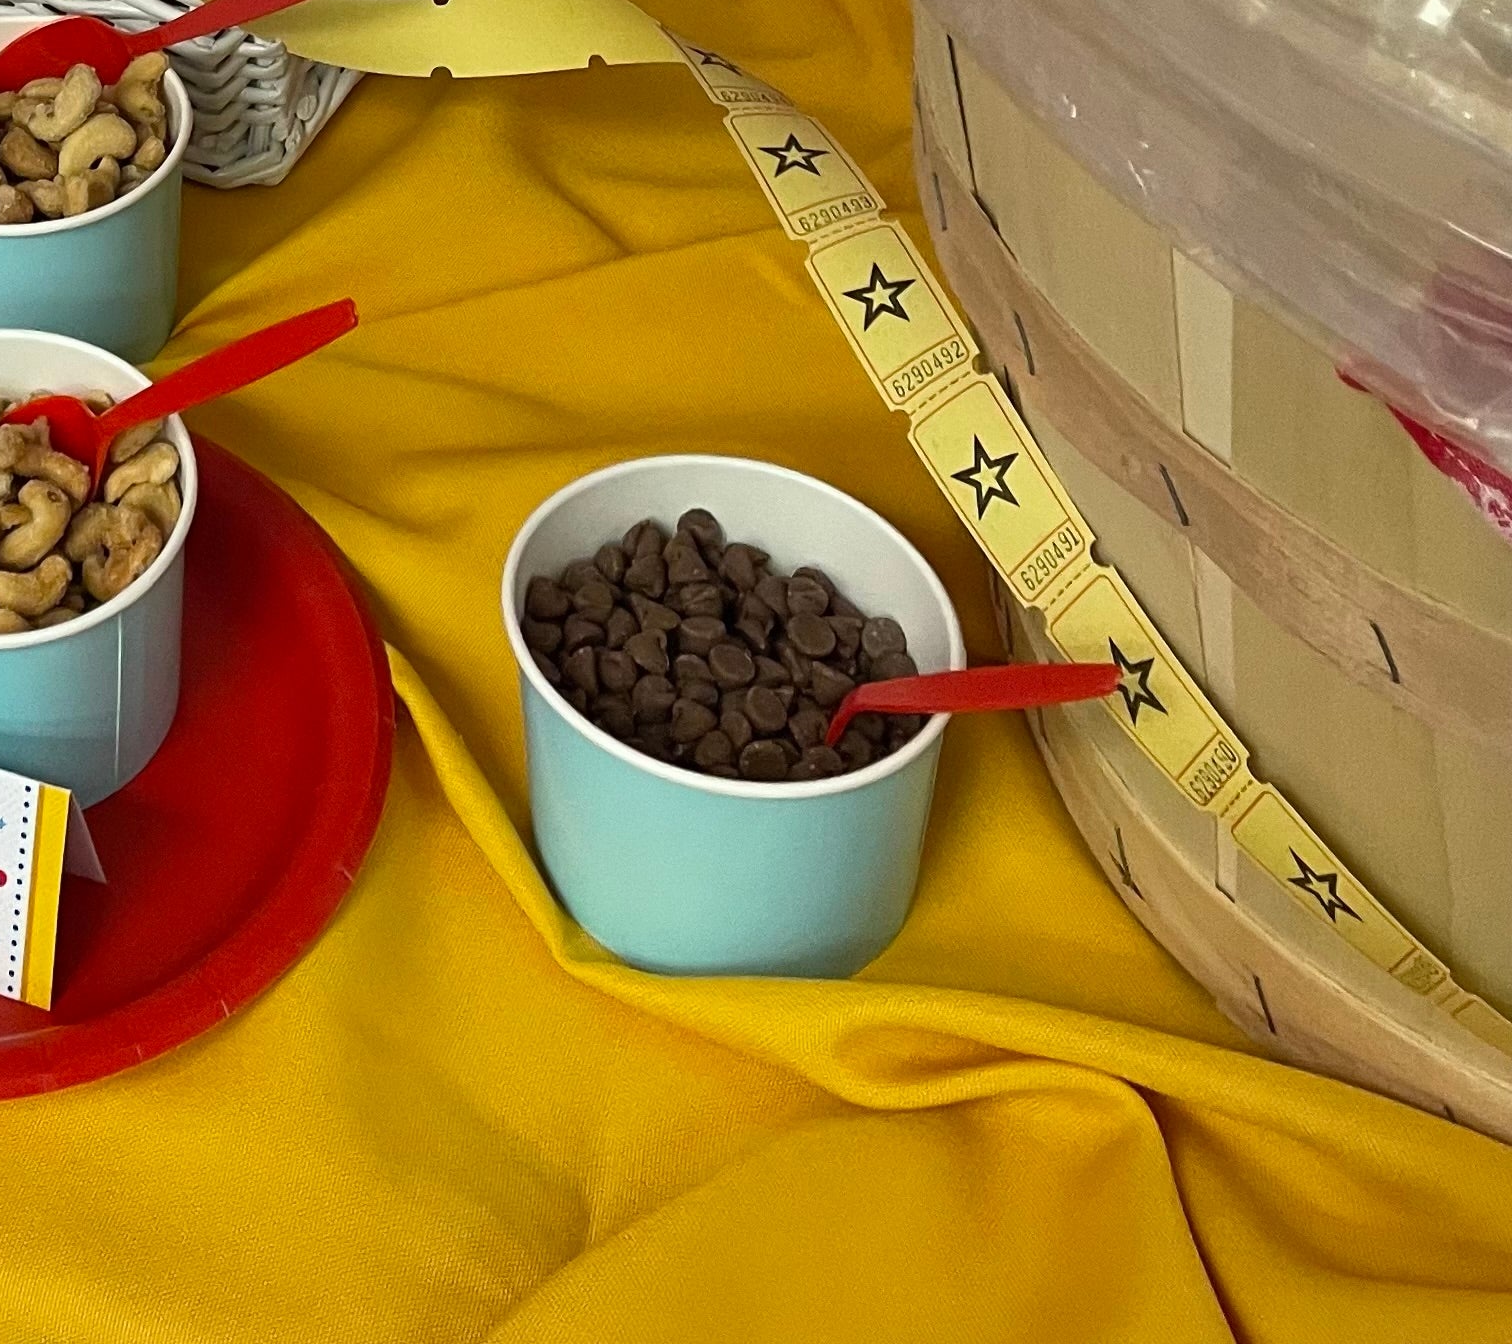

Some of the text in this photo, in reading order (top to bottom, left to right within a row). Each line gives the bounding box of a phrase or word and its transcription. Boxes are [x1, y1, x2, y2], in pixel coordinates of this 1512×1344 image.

[798, 196, 873, 233] 6290493
[892, 340, 965, 398] 6290492
[1020, 526, 1081, 592] 6290491
